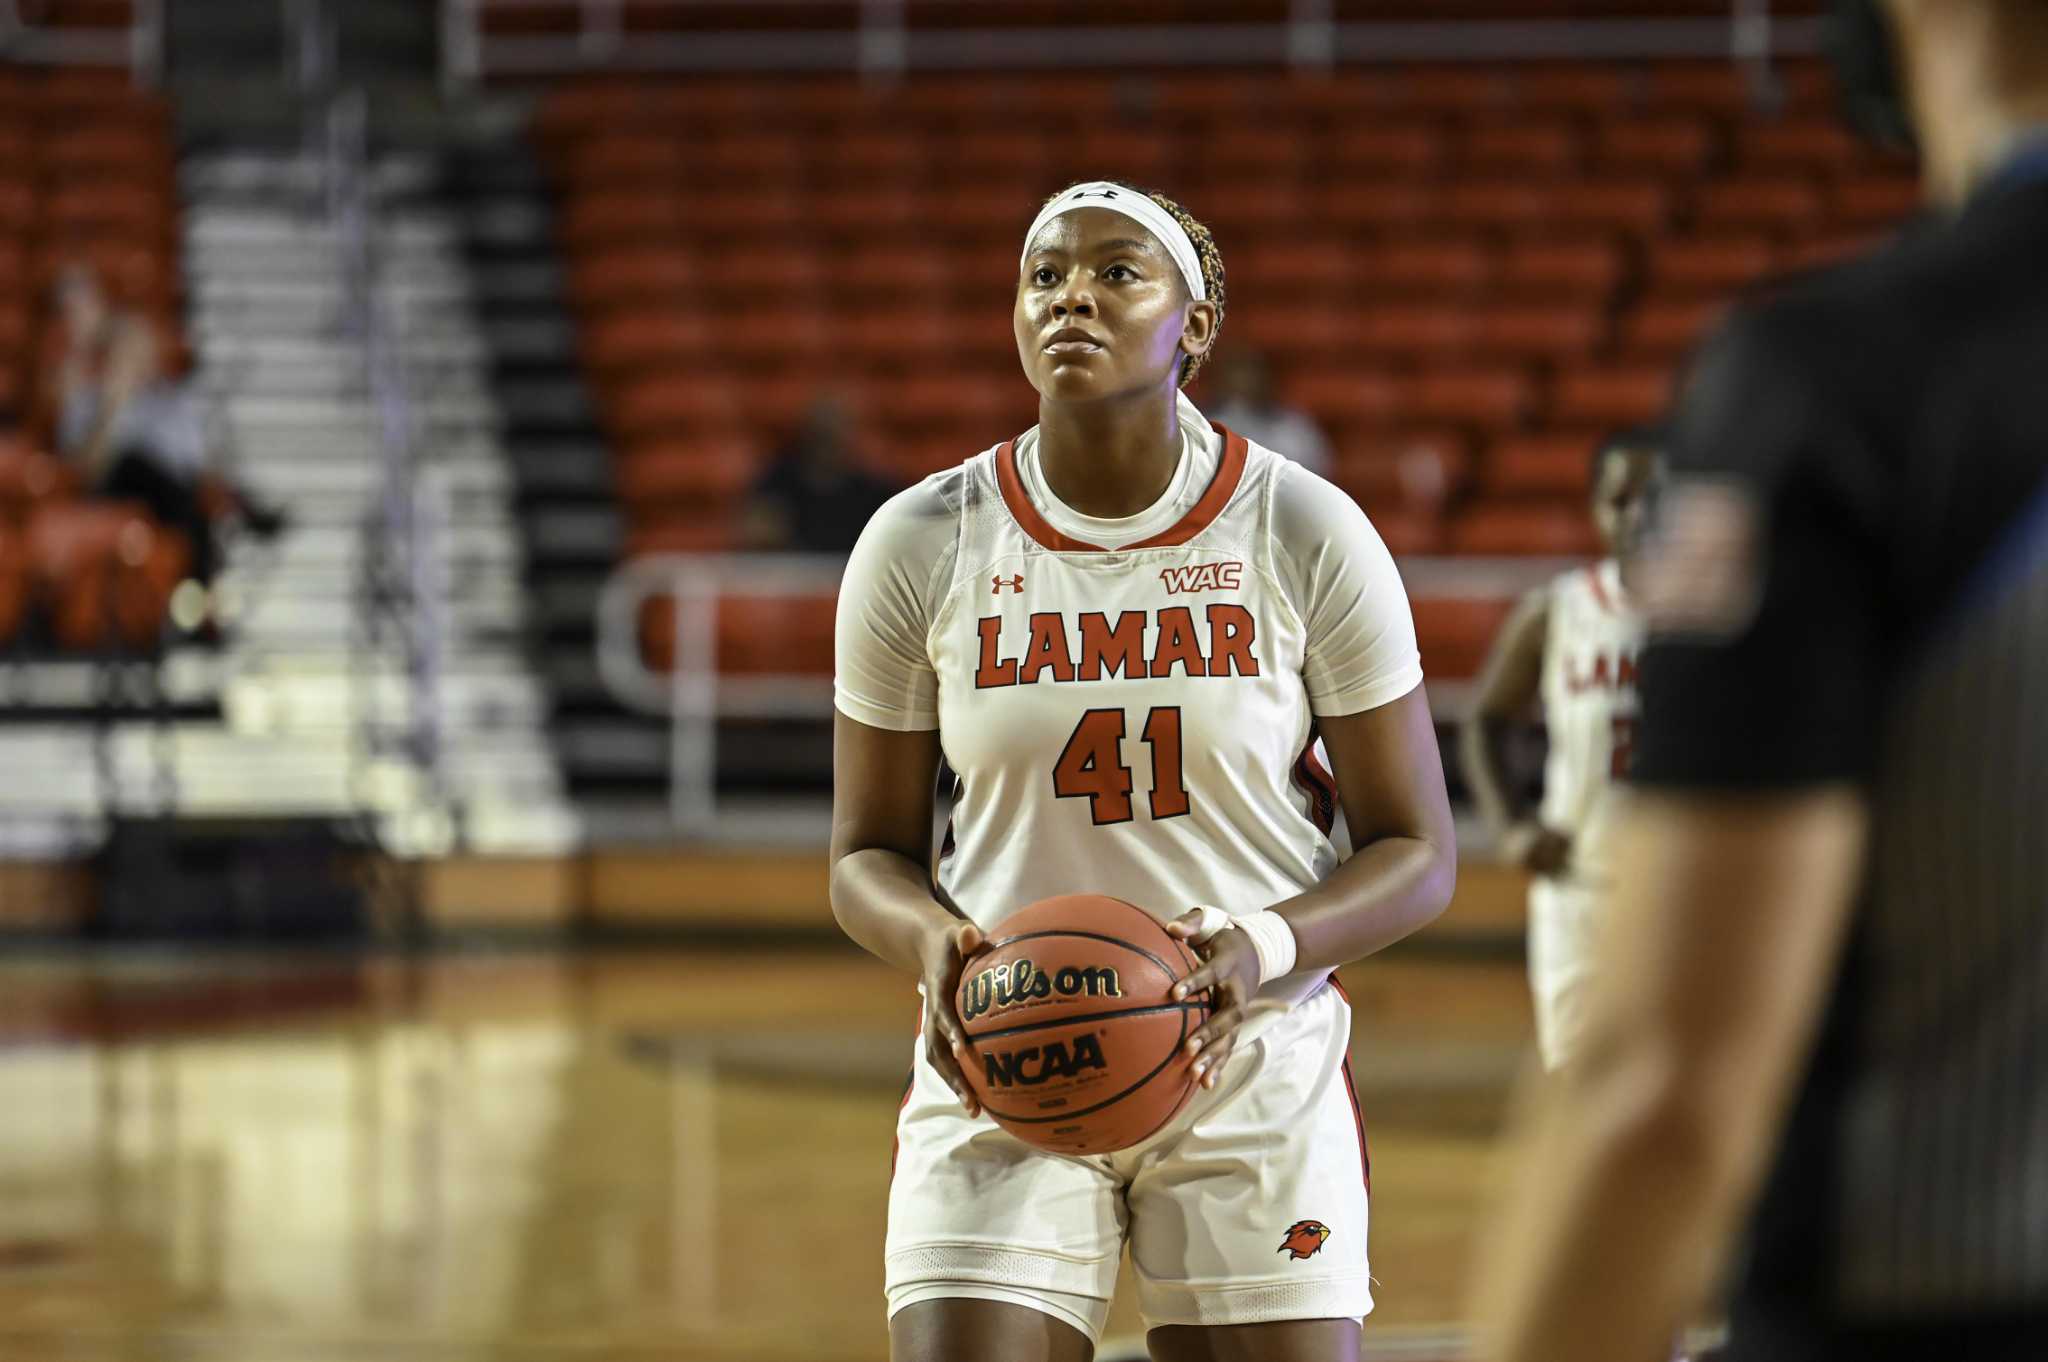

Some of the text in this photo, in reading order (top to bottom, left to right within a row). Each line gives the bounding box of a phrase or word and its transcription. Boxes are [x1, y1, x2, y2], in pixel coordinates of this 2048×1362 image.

[1160, 562, 1243, 595] WAC
[975, 604, 1260, 689] LAMAR
[1053, 705, 1191, 826] 41
[962, 958, 1123, 1023] Wilson
[983, 1032, 1107, 1088] NCAA
